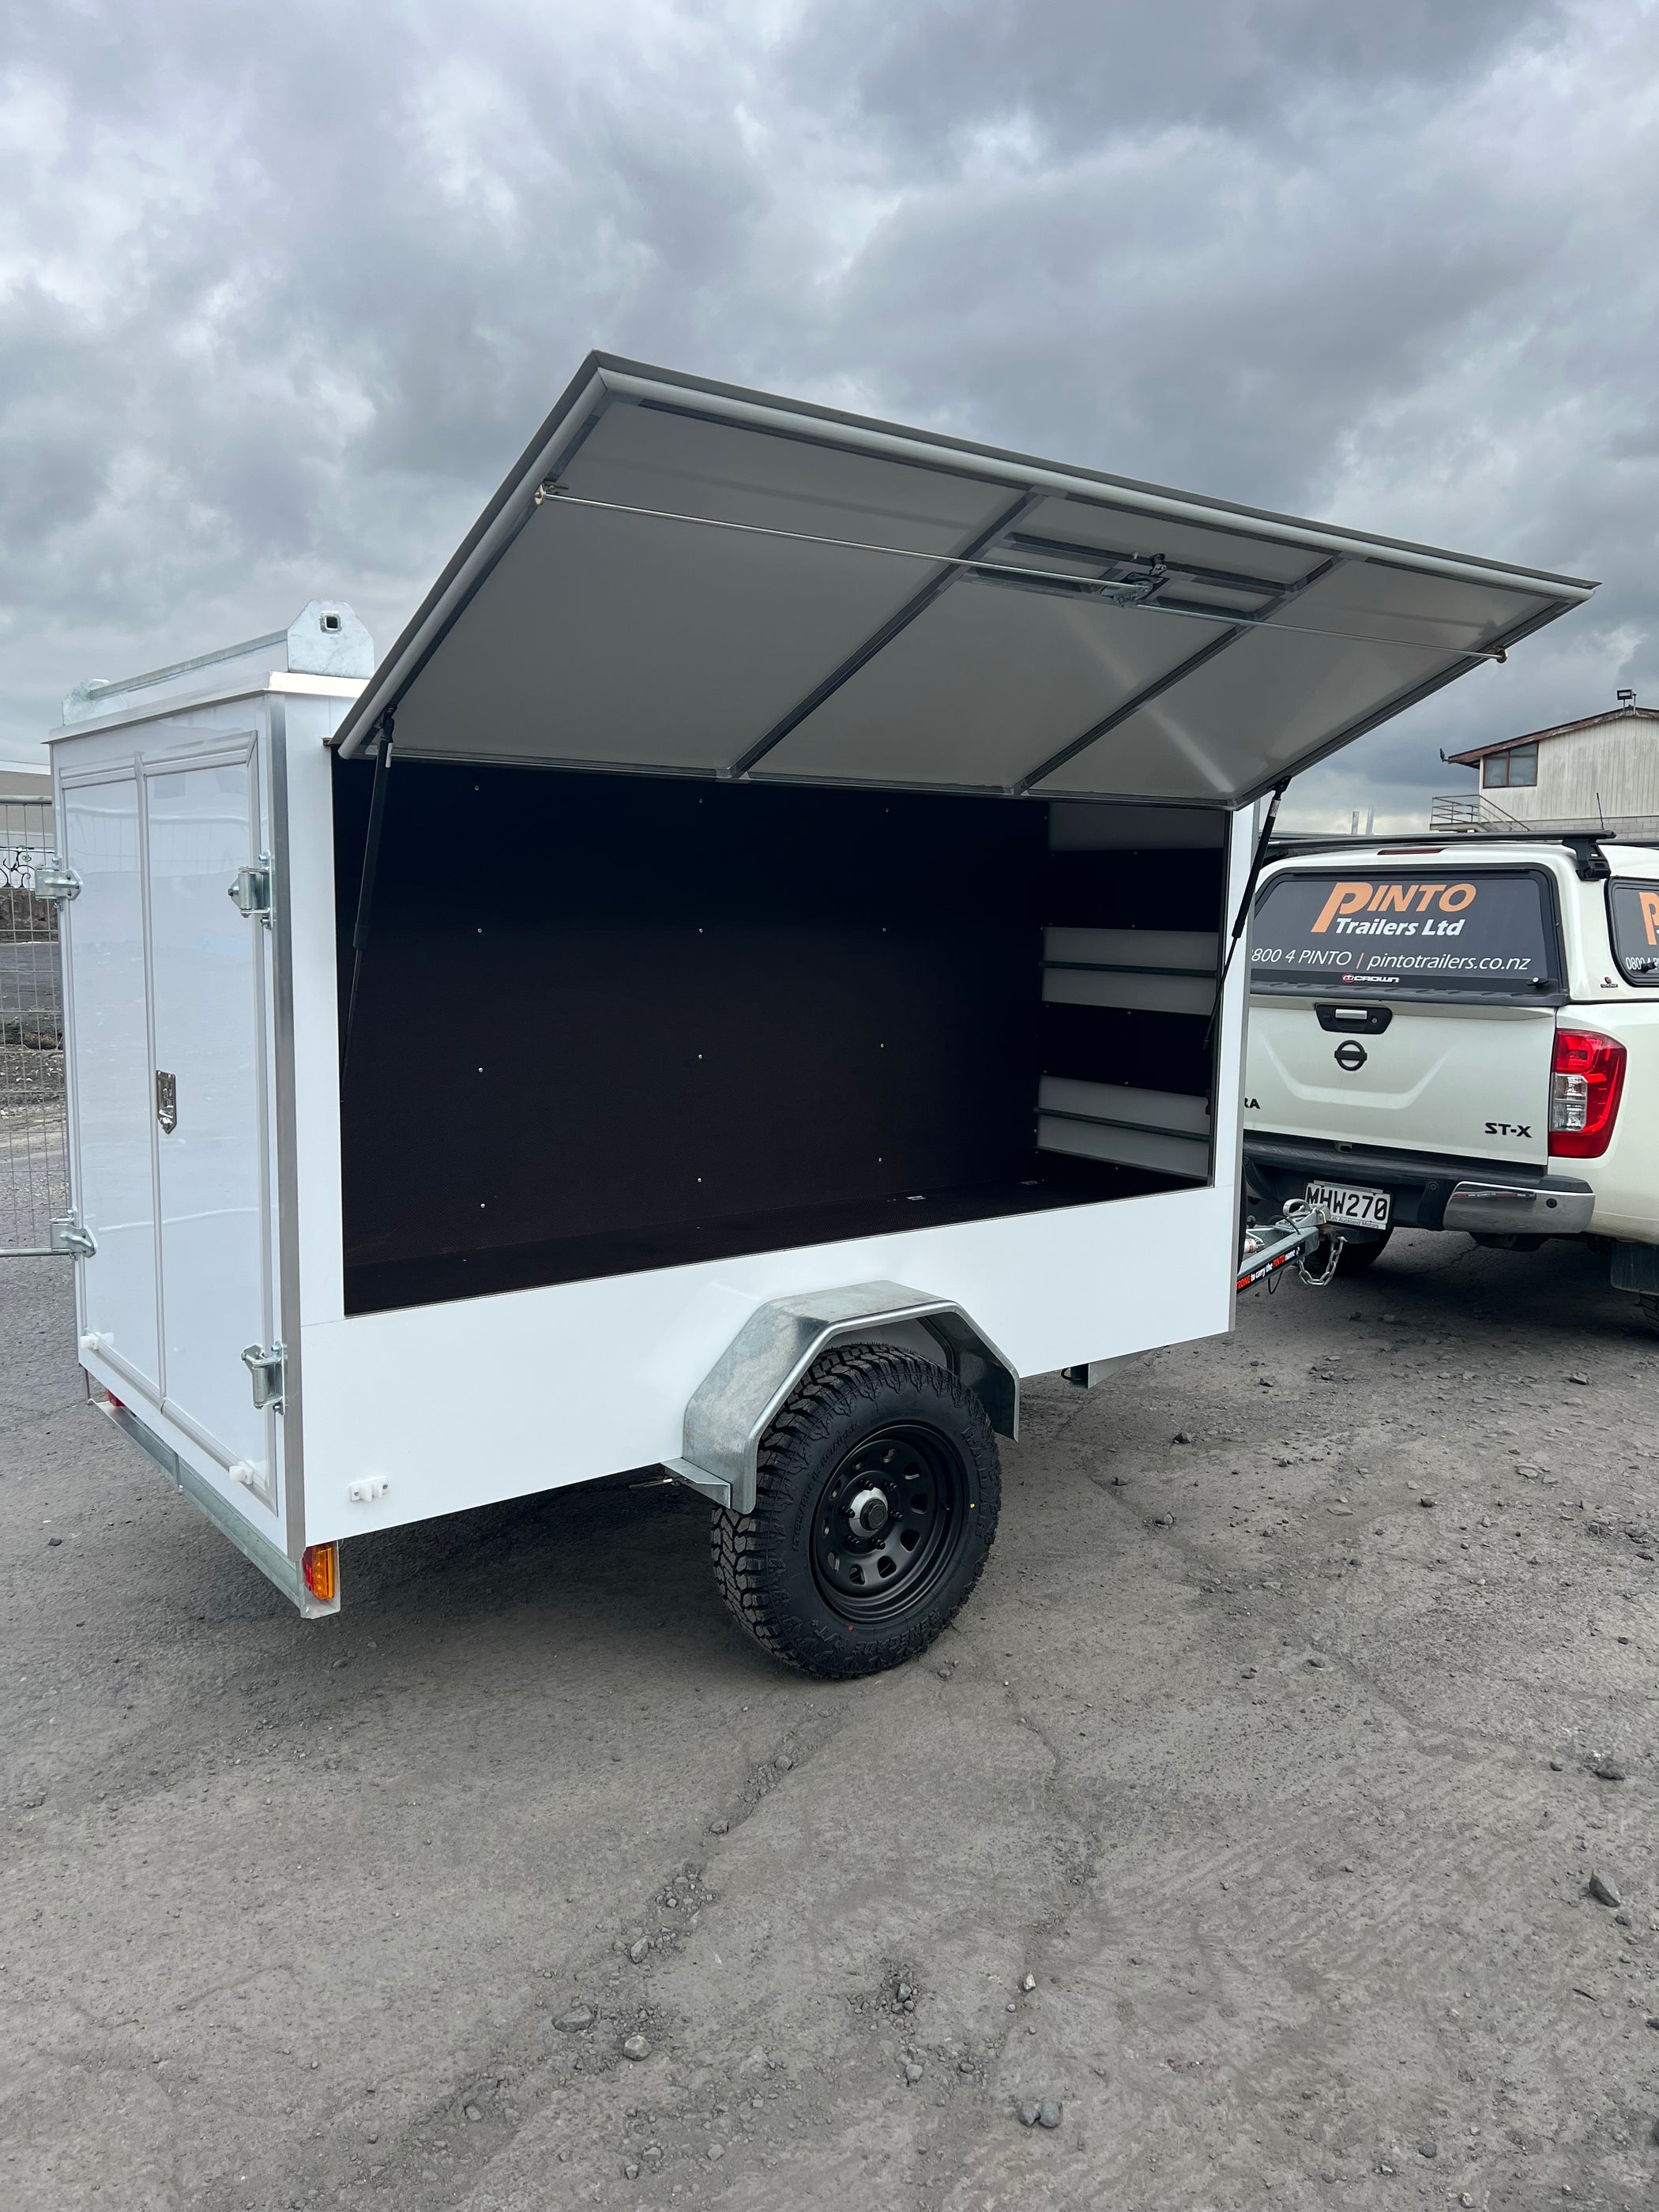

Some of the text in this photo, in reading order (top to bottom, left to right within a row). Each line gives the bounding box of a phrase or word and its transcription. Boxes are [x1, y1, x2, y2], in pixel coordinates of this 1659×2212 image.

[1311, 882, 1477, 933] PINTO
[1335, 917, 1466, 936] Trailers Ltd
[1251, 948, 1282, 962] 800
[1285, 950, 1296, 963] 4
[1298, 950, 1352, 965] PINTO
[1366, 953, 1531, 971] pintotrailers.co.nz
[1484, 1122, 1533, 1138] ST-X
[1306, 1186, 1388, 1221] MHW270
[1361, 1221, 1379, 1229] Motors
[1251, 1273, 1256, 1281] to
[1255, 1266, 1266, 1279] carry
[1273, 1254, 1285, 1268] PINTO
[1285, 1249, 1296, 1262] name
